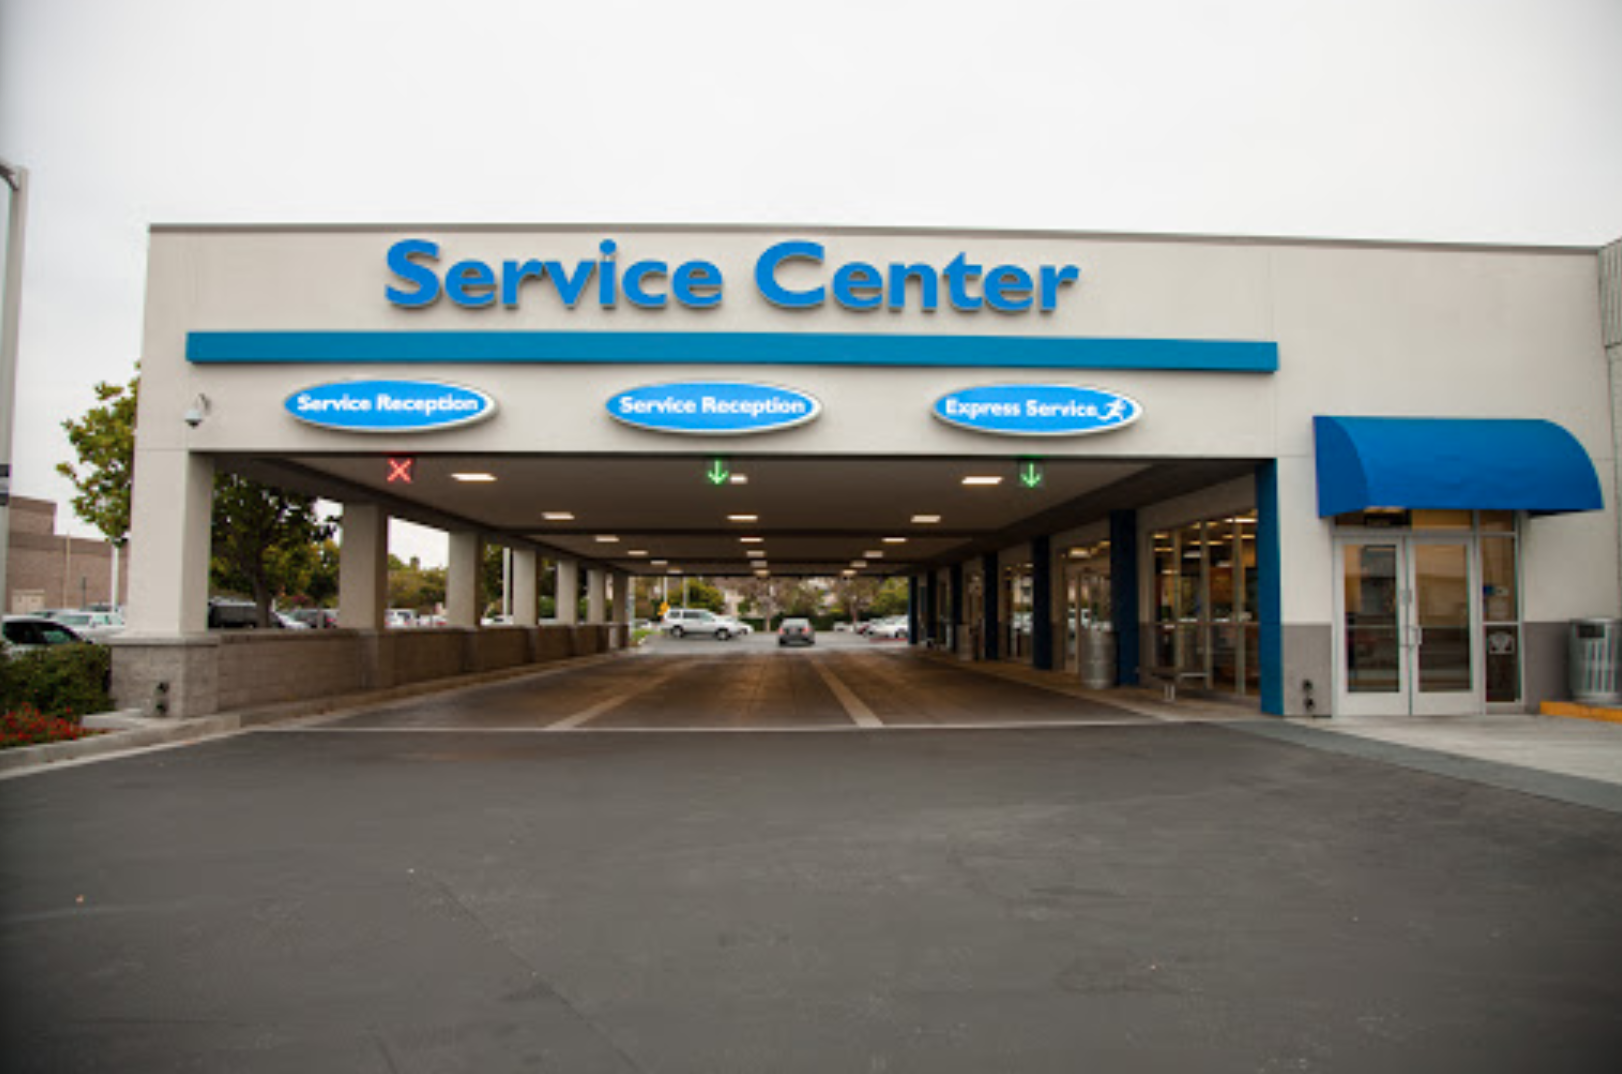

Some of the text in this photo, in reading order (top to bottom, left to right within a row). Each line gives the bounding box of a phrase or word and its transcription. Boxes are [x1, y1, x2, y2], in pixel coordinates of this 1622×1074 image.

[384, 239, 1080, 313] Service Center
[297, 393, 479, 417] Service Reception
[618, 396, 806, 418] Service Reception
[945, 399, 1098, 420] Express Service
